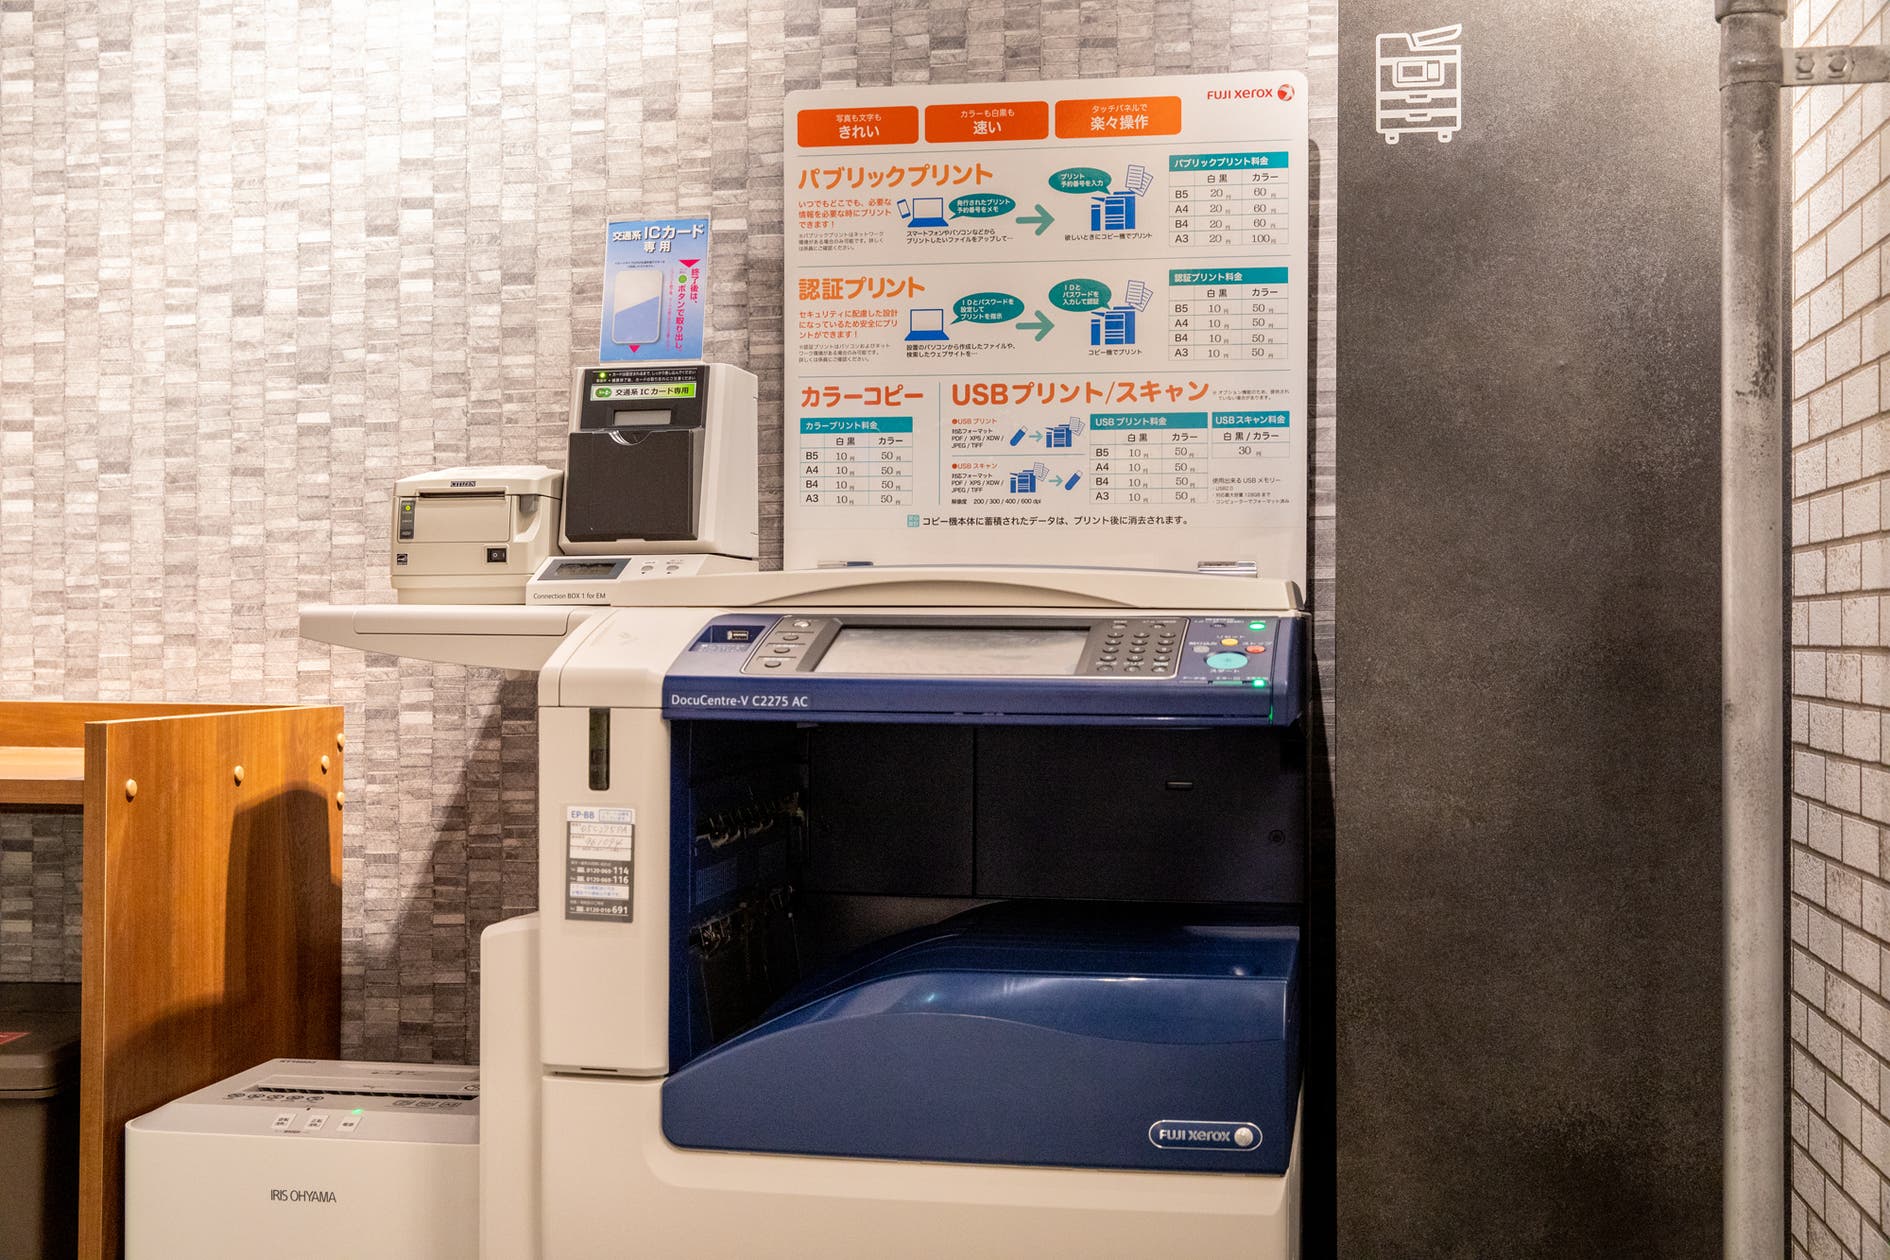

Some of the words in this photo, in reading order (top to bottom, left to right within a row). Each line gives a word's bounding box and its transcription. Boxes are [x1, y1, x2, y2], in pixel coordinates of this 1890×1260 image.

[1207, 90, 1231, 100] FUJI
[1092, 104, 1148, 113] タッチパネルで
[836, 113, 882, 122] 写真も文字も
[960, 109, 1015, 118] カラーも白黒も
[1090, 115, 1149, 131] 楽々操作
[839, 126, 880, 139] きれい
[973, 121, 1002, 135] 速い
[1174, 157, 1268, 167] パブリックプリント料金
[798, 163, 993, 189] パブリックプリント
[1252, 173, 1279, 182] カラー
[1060, 179, 1104, 188] 予約番号を入力
[1175, 190, 1188, 198] B5
[798, 198, 891, 208] いつでもどこでも、必要な
[799, 209, 892, 218] 情報を必要な時にプリント
[957, 205, 999, 213] 予約番号をメモ
[1175, 205, 1188, 214] A4
[1175, 220, 1188, 228] B4
[906, 229, 996, 237] スマートフォンやパソコンなどから
[1065, 233, 1152, 241] 欲しいときにコピー機でプリント
[1175, 234, 1189, 243] A3
[1174, 272, 1243, 282] 認証プリント料金
[799, 276, 925, 300] 認証プリント
[1252, 288, 1278, 297] カラー
[1175, 305, 1188, 313] B5
[800, 309, 898, 319] セキュリティに配慮した設計
[799, 320, 898, 329] になっているため安全にプリ
[1175, 319, 1188, 328] A4
[1175, 334, 1188, 342] B4
[1088, 348, 1143, 356] コピー機でプリント
[1175, 348, 1188, 357] A3
[801, 384, 923, 408] カラーコピー
[806, 421, 878, 430] カラープリント料金
[1096, 417, 1167, 426] USBプリント料金
[1172, 433, 1198, 441] カラー
[1253, 432, 1279, 440] カラー
[878, 437, 903, 445] カラー
[806, 452, 819, 460] B5
[1096, 449, 1109, 457] B5
[806, 466, 819, 474] A4
[1096, 463, 1109, 471] A4
[806, 480, 818, 489] B4
[1096, 478, 1108, 486] B4
[806, 494, 819, 503] A3
[1096, 492, 1109, 500] A3
[672, 695, 748, 706] DocuCentre-V
[752, 696, 788, 707] C2275
[792, 696, 808, 707] AC
[1159, 1129, 1185, 1140] FUJI
[271, 1190, 288, 1201] IRIS
[290, 1190, 336, 1203] OHYAMA
